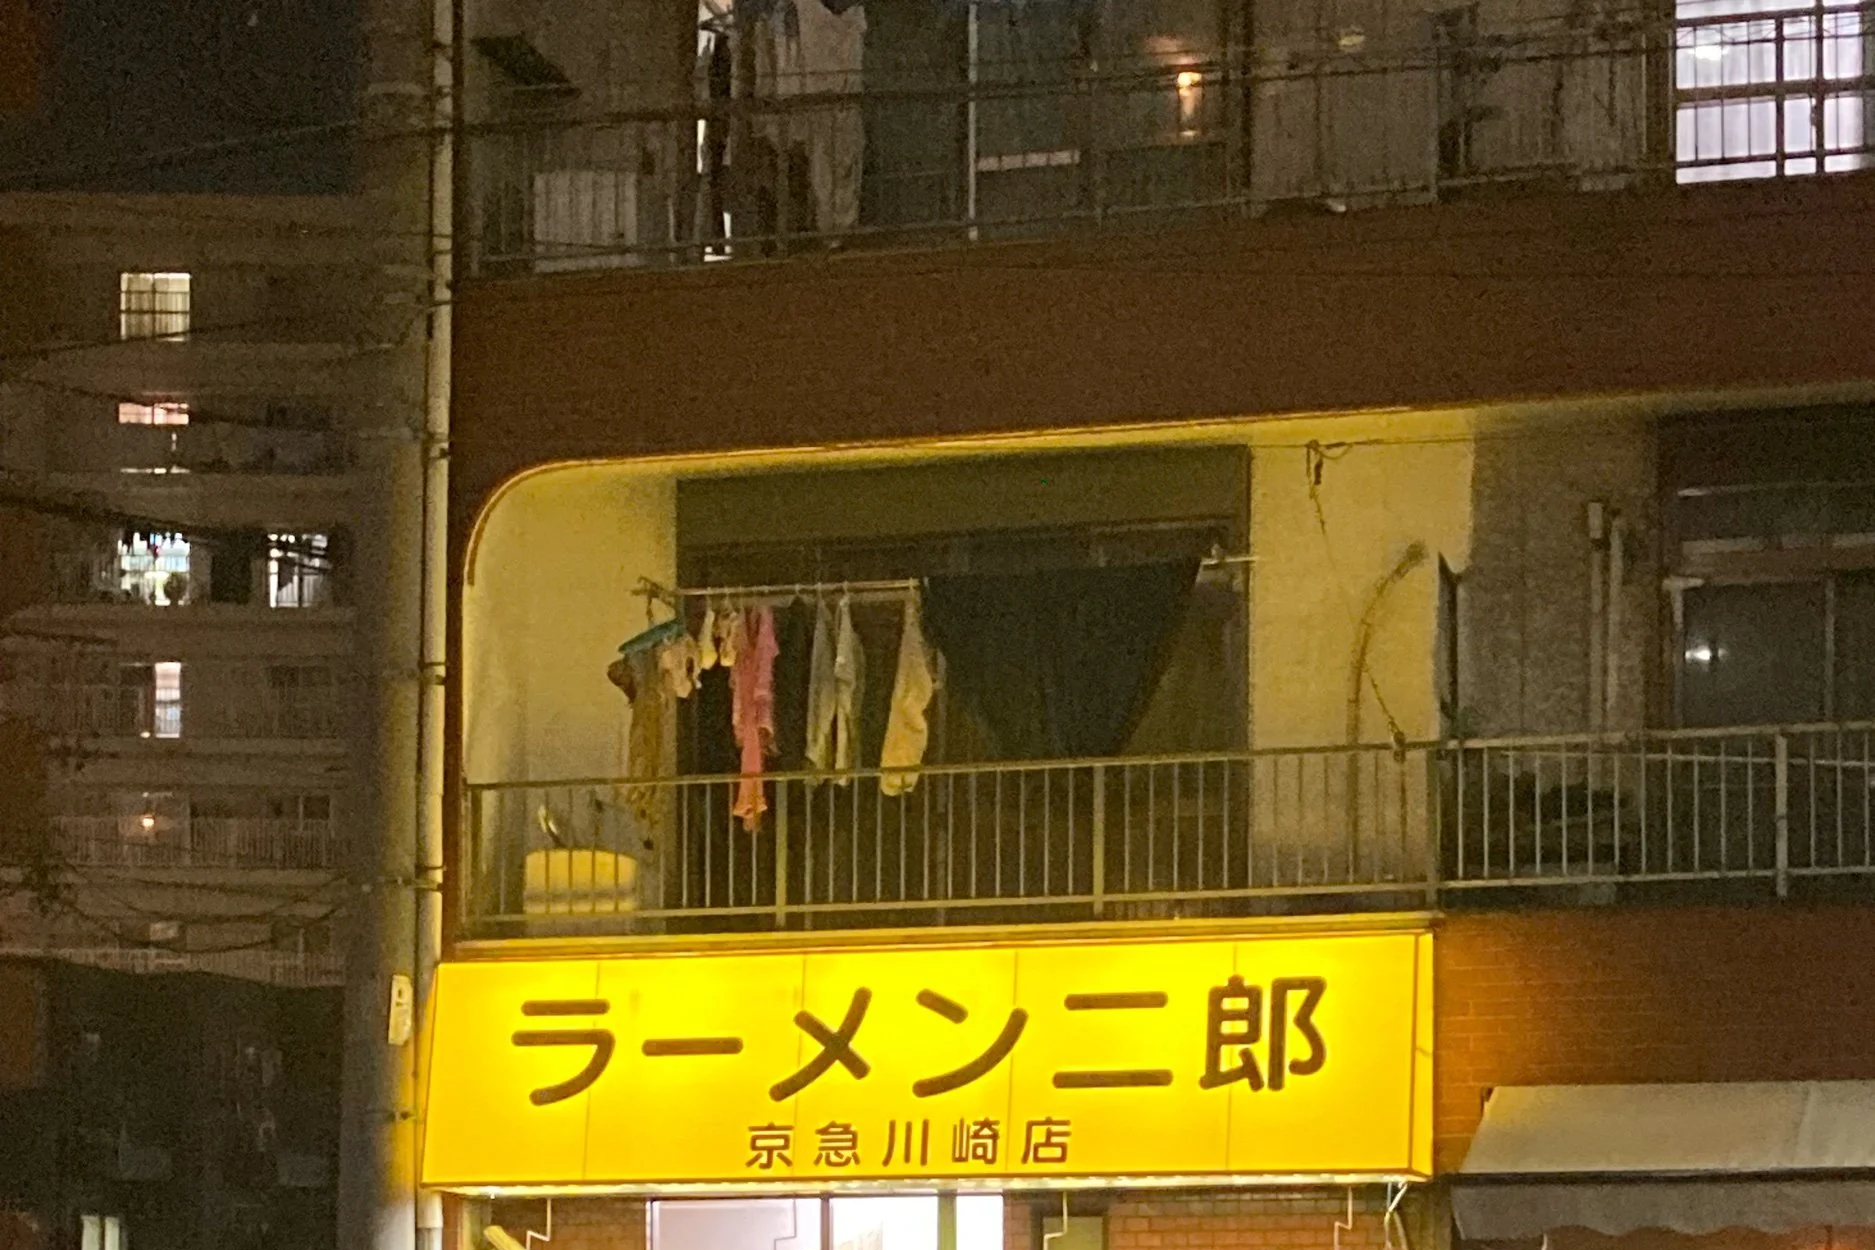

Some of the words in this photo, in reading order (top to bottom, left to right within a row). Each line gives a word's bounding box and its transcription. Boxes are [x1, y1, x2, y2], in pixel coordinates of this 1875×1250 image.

[511, 974, 1328, 1107] ラーメン二郎
[746, 1116, 1072, 1170] 京急川崎店
